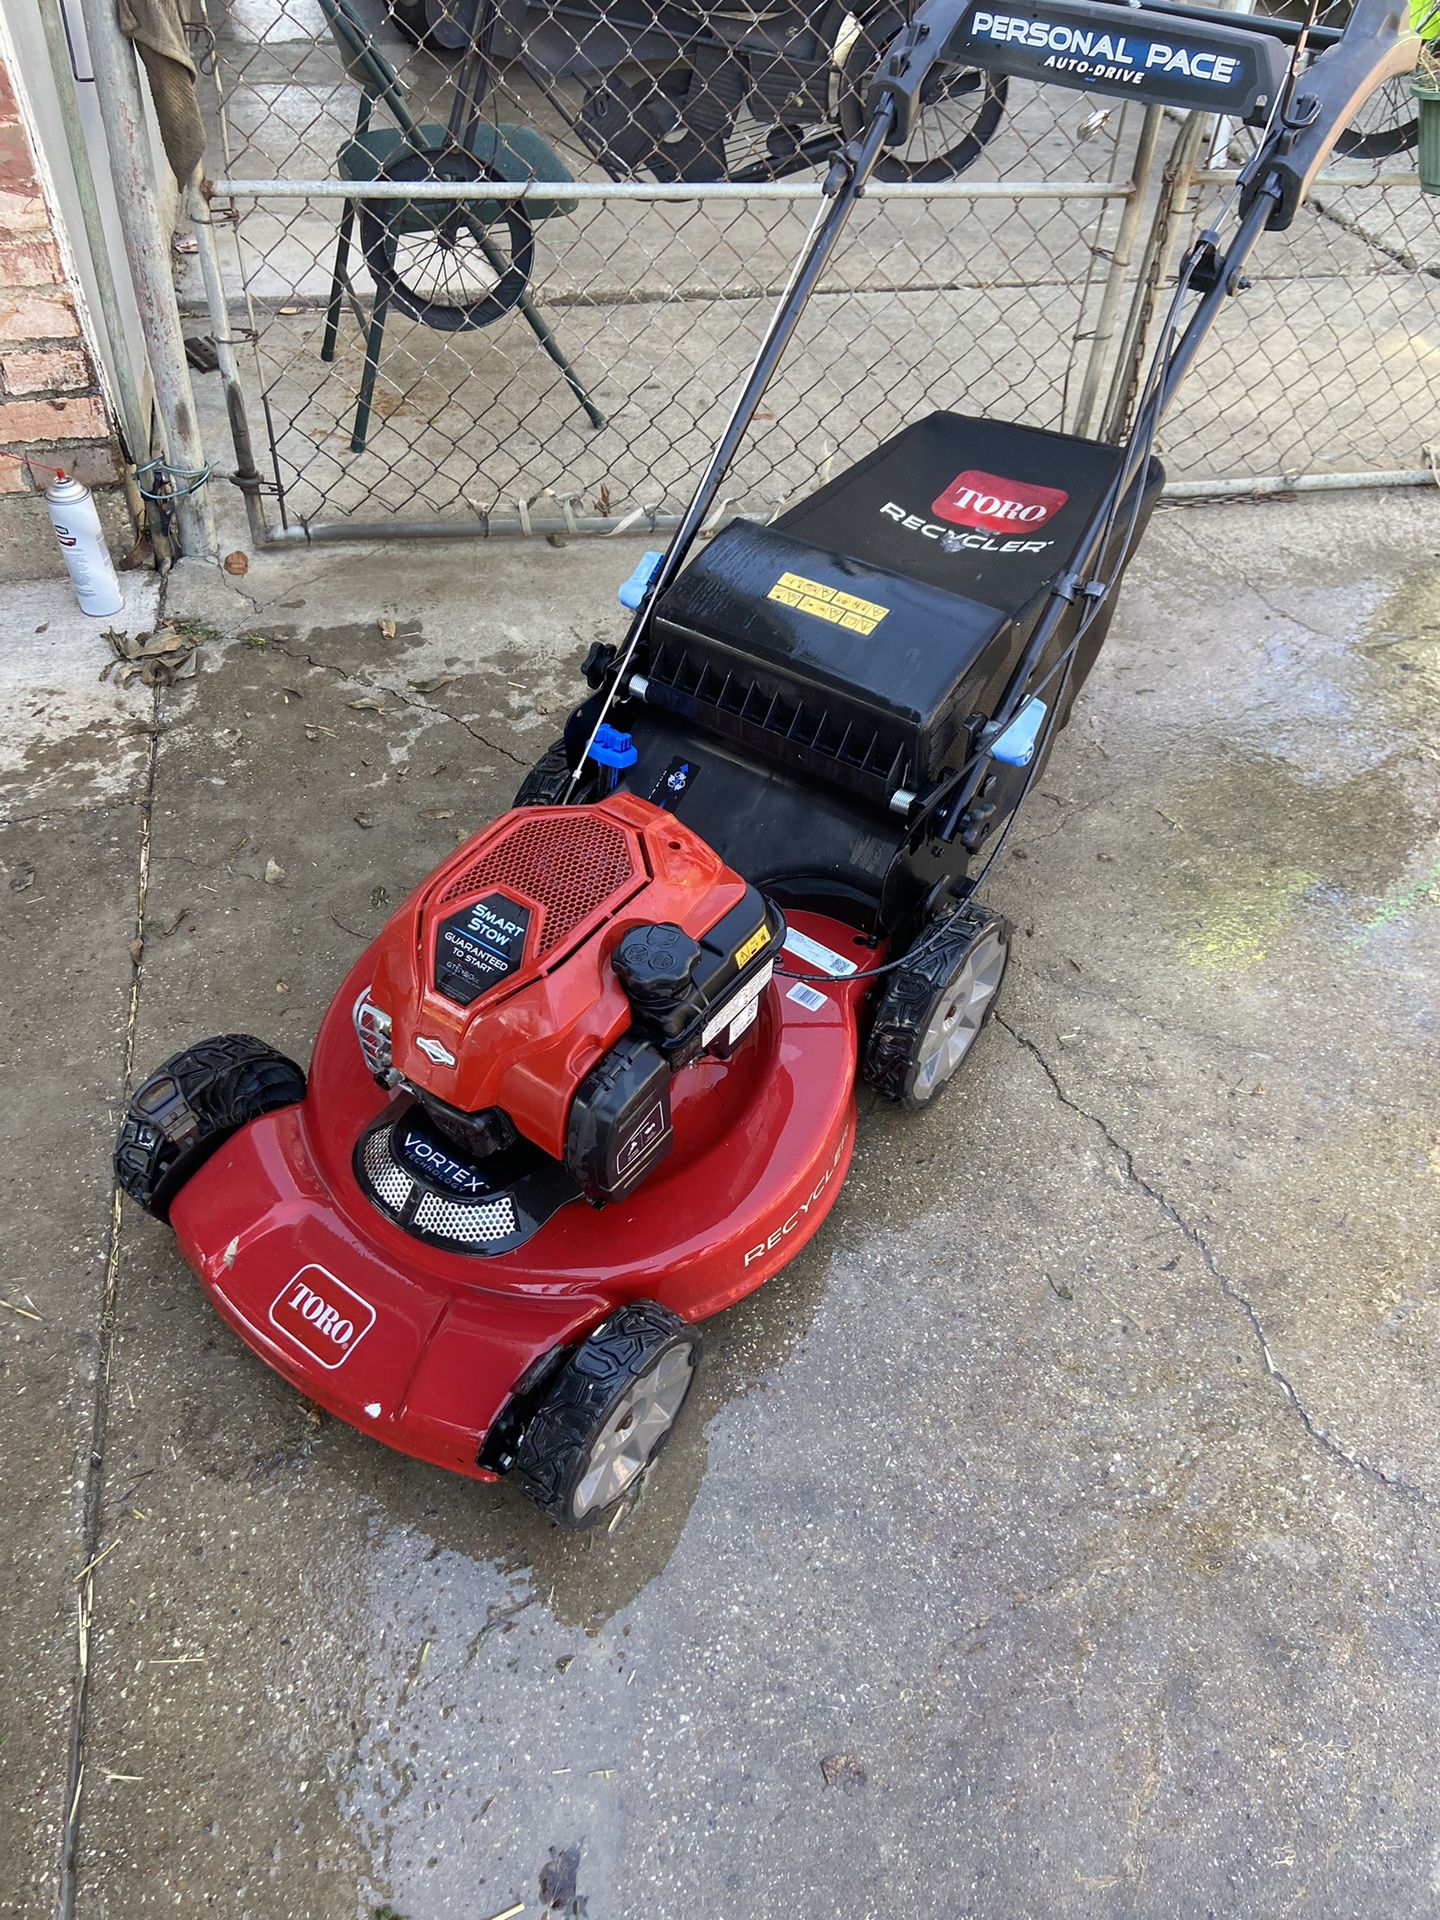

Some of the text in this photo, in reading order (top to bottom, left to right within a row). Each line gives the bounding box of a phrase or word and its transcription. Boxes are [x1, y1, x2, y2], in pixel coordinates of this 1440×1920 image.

[971, 11, 1237, 84] PERSONAL PACE
[1043, 55, 1146, 85] AUTO-DRIVE
[952, 486, 1048, 522] TORO
[879, 501, 1049, 553] RECYCLER
[467, 917, 510, 946] STOW
[472, 903, 525, 937] SMART
[444, 931, 508, 972] GUARANTEED
[452, 947, 493, 973] TO START
[403, 1150, 466, 1193] TECHNOLOGY
[404, 1132, 485, 1192] VORTEX
[288, 1282, 354, 1344] TORO
